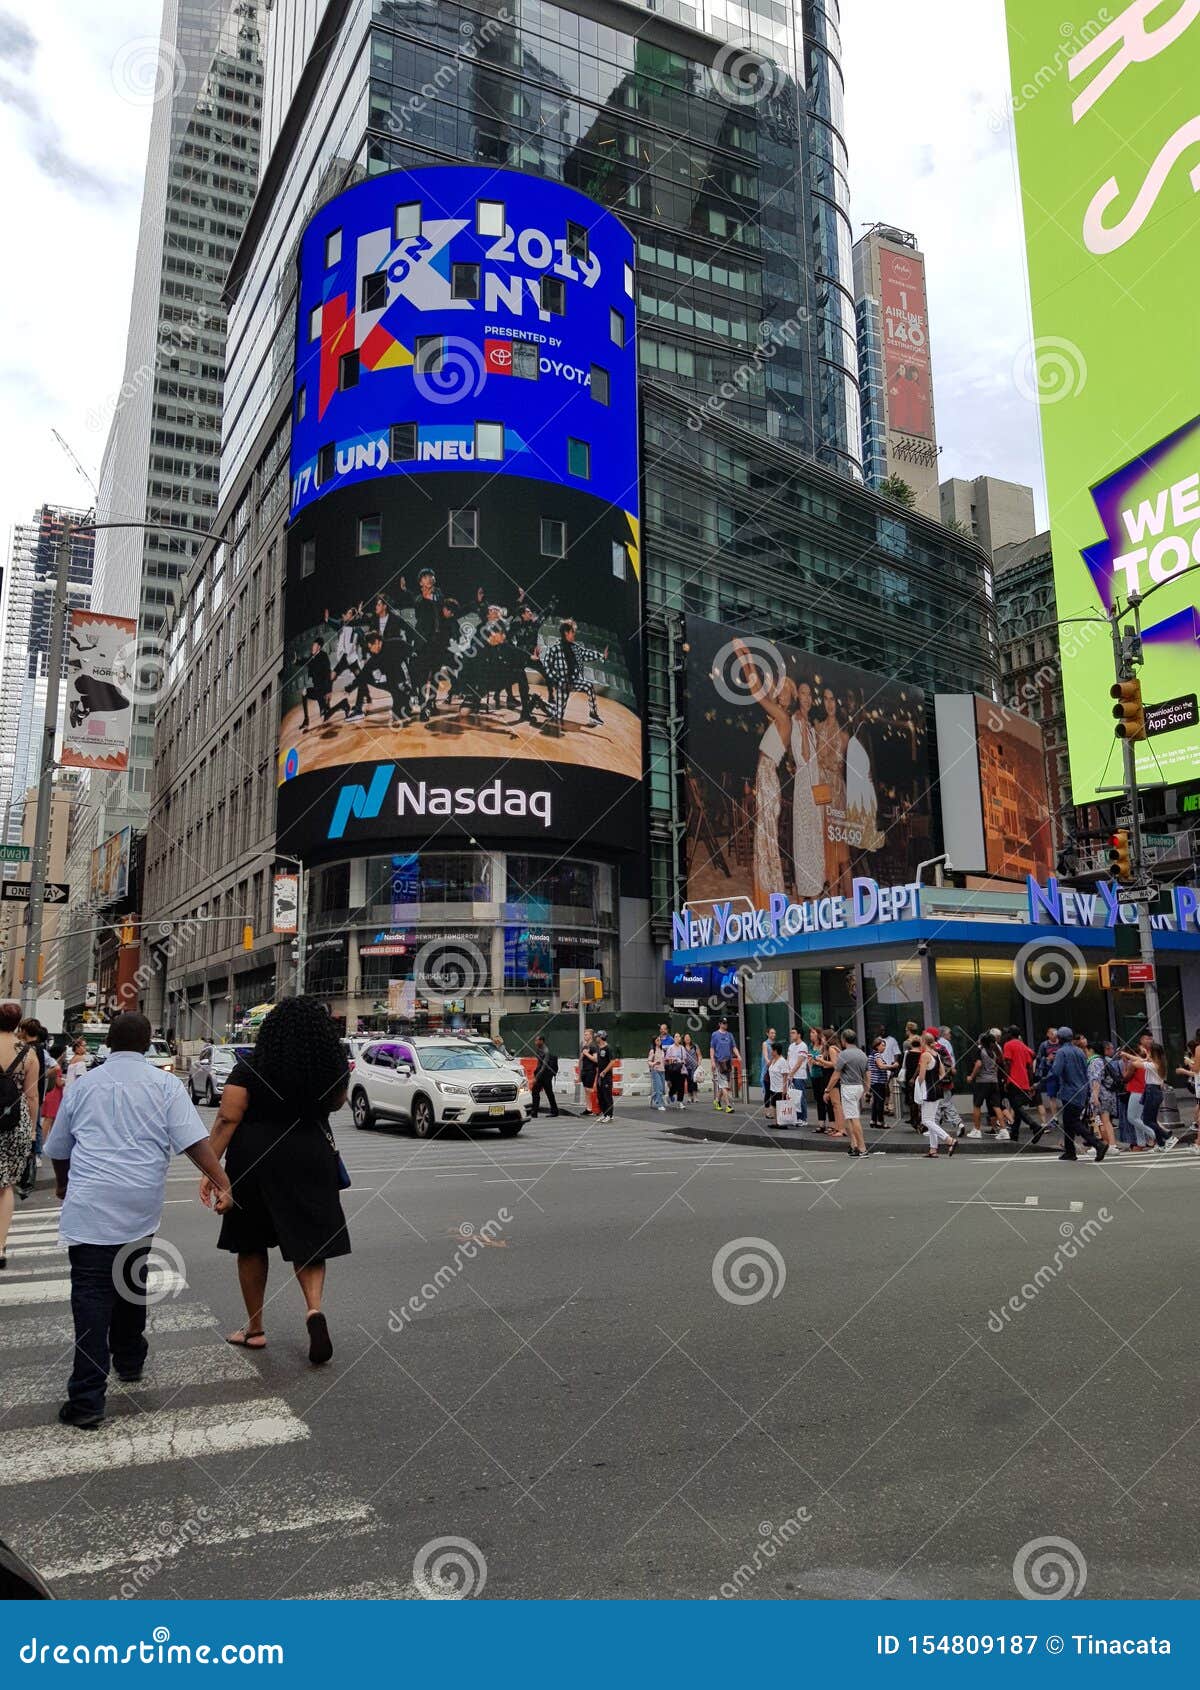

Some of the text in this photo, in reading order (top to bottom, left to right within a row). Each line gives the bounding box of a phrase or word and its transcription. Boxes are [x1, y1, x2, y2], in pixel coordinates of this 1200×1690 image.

[485, 223, 601, 288] 2019
[900, 291, 907, 310] 1
[886, 305, 924, 325] AIRLINE
[484, 325, 562, 347] PRESENTED BY
[886, 318, 925, 346] 140
[539, 357, 592, 387] OYOTA
[314, 438, 389, 490] (UN)
[1148, 711, 1192, 730] App Store
[397, 780, 551, 827] Nasdaq
[11, 887, 31, 896] ONE
[1026, 874, 1097, 926] NEW
[672, 877, 921, 950] NEW YORK POLICE DEPT
[683, 975, 704, 983] Nasdaq
